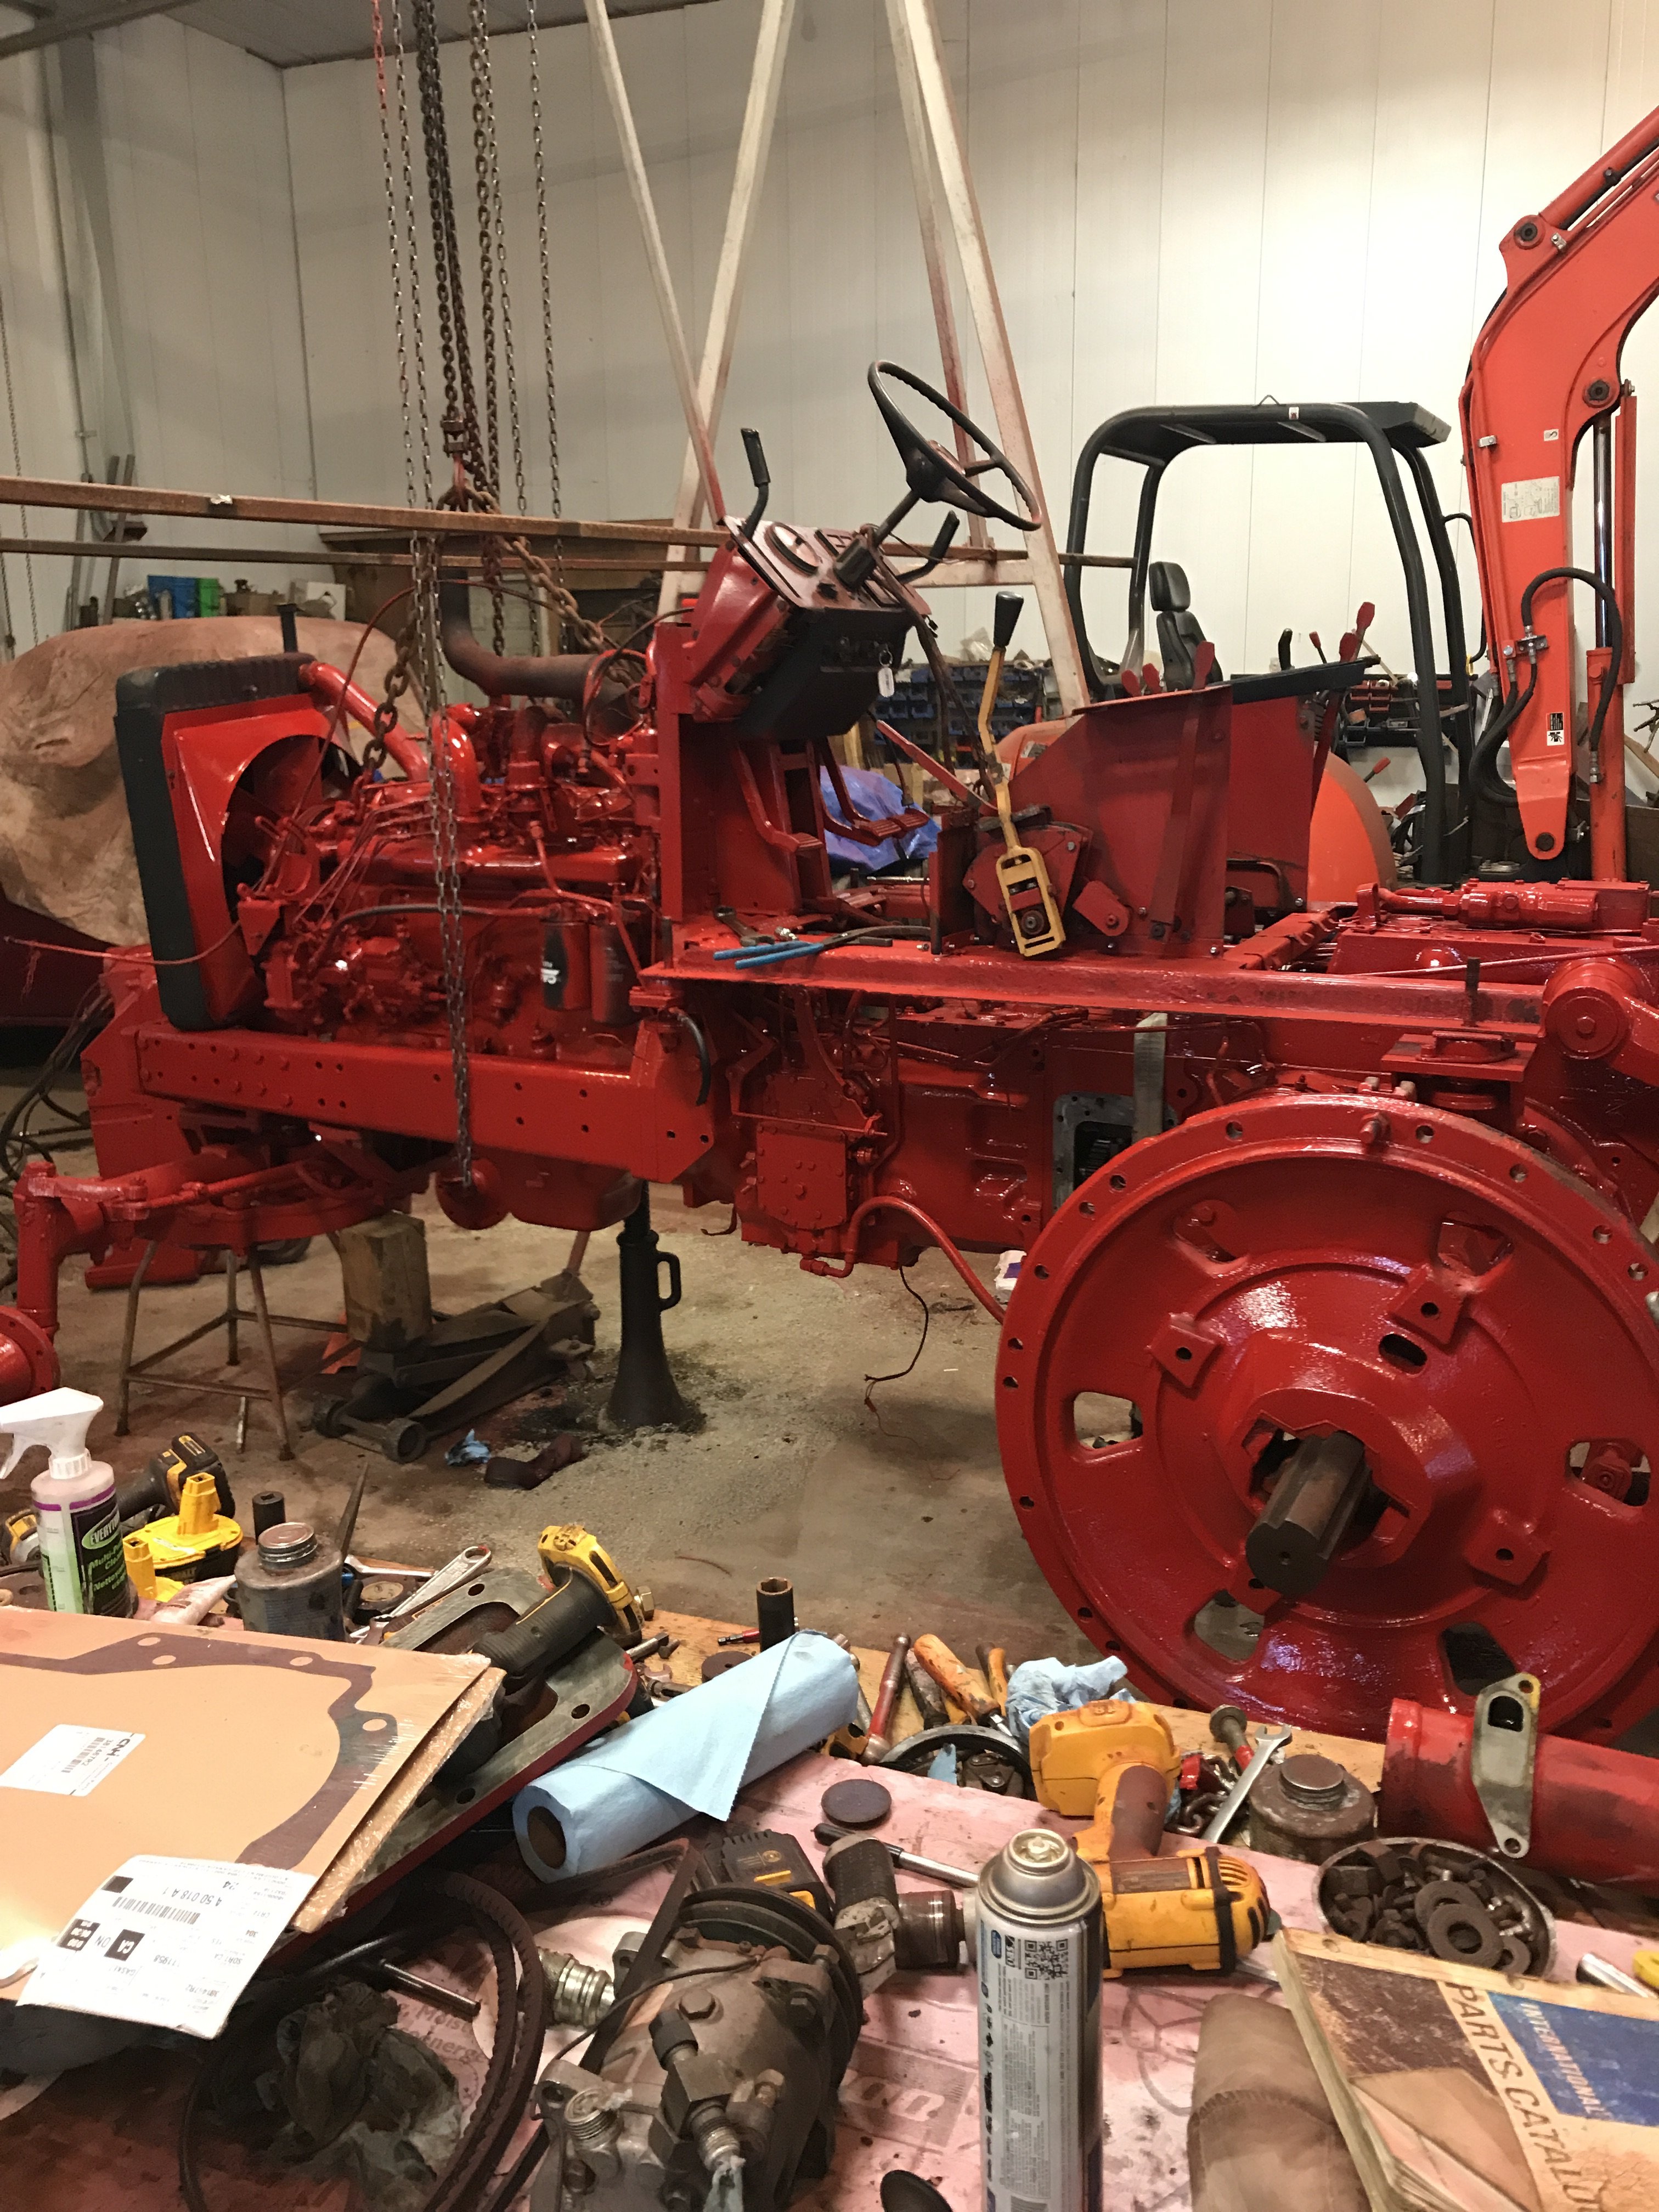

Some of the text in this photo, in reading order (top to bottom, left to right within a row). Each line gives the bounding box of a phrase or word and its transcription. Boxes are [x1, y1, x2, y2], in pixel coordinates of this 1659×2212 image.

[94, 1935, 111, 1948] ON
[117, 1939, 135, 1954] CA
[1445, 1982, 1602, 2212] PARTS CATALO
